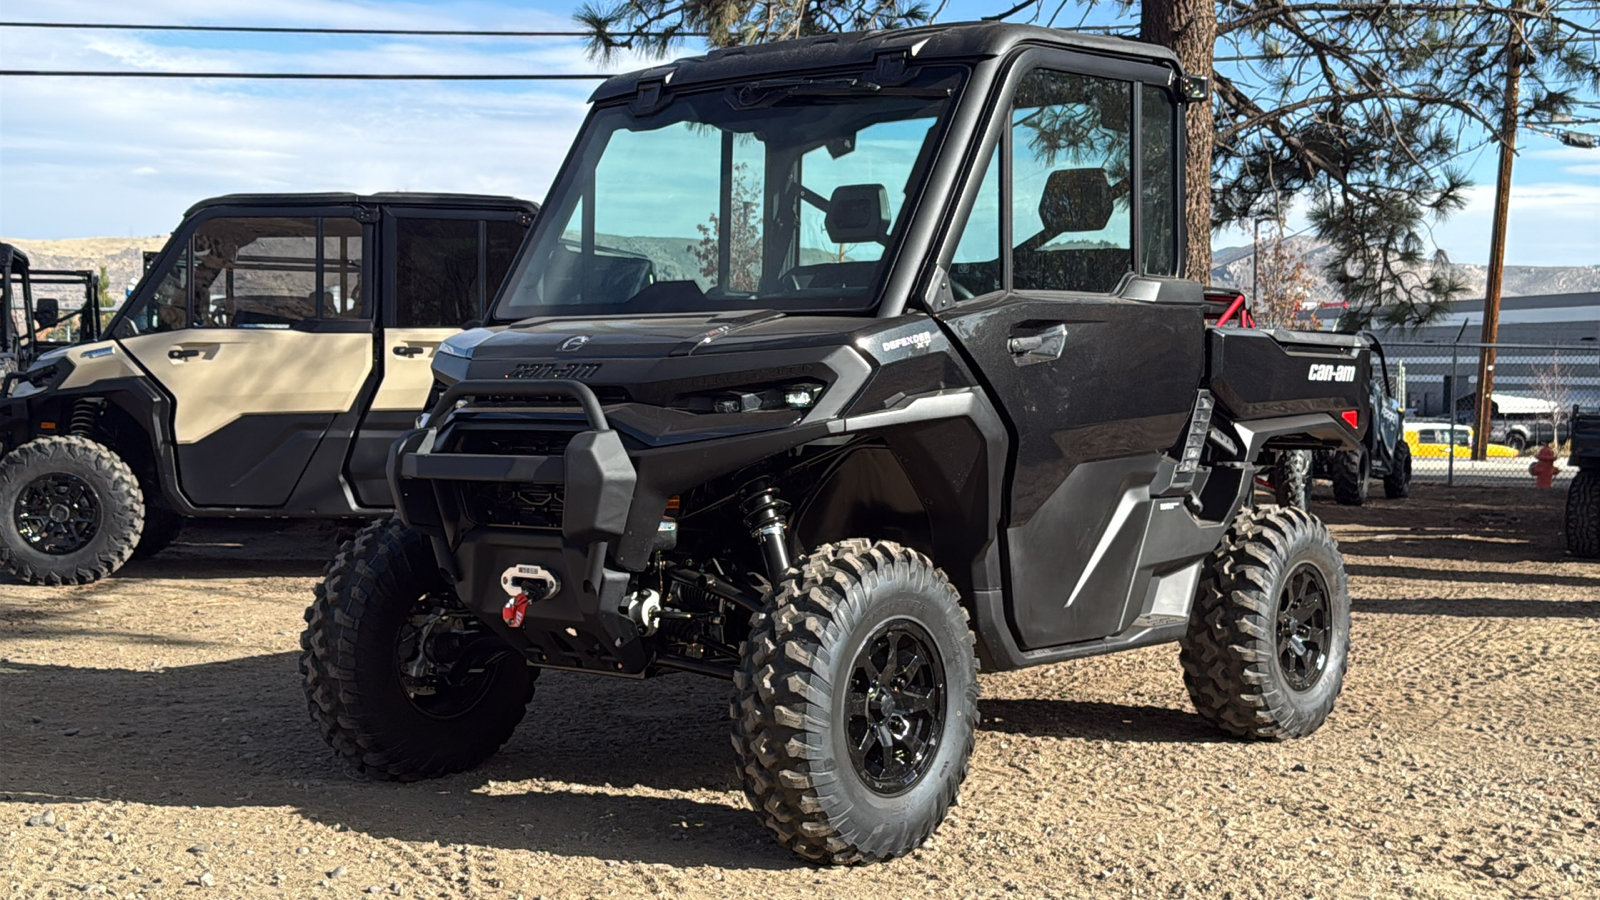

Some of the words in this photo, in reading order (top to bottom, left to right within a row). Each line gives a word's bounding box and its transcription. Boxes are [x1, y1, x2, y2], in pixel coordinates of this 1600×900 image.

[882, 331, 932, 352] DEFENDER
[916, 340, 931, 350] XT
[1308, 363, 1356, 382] can-am
